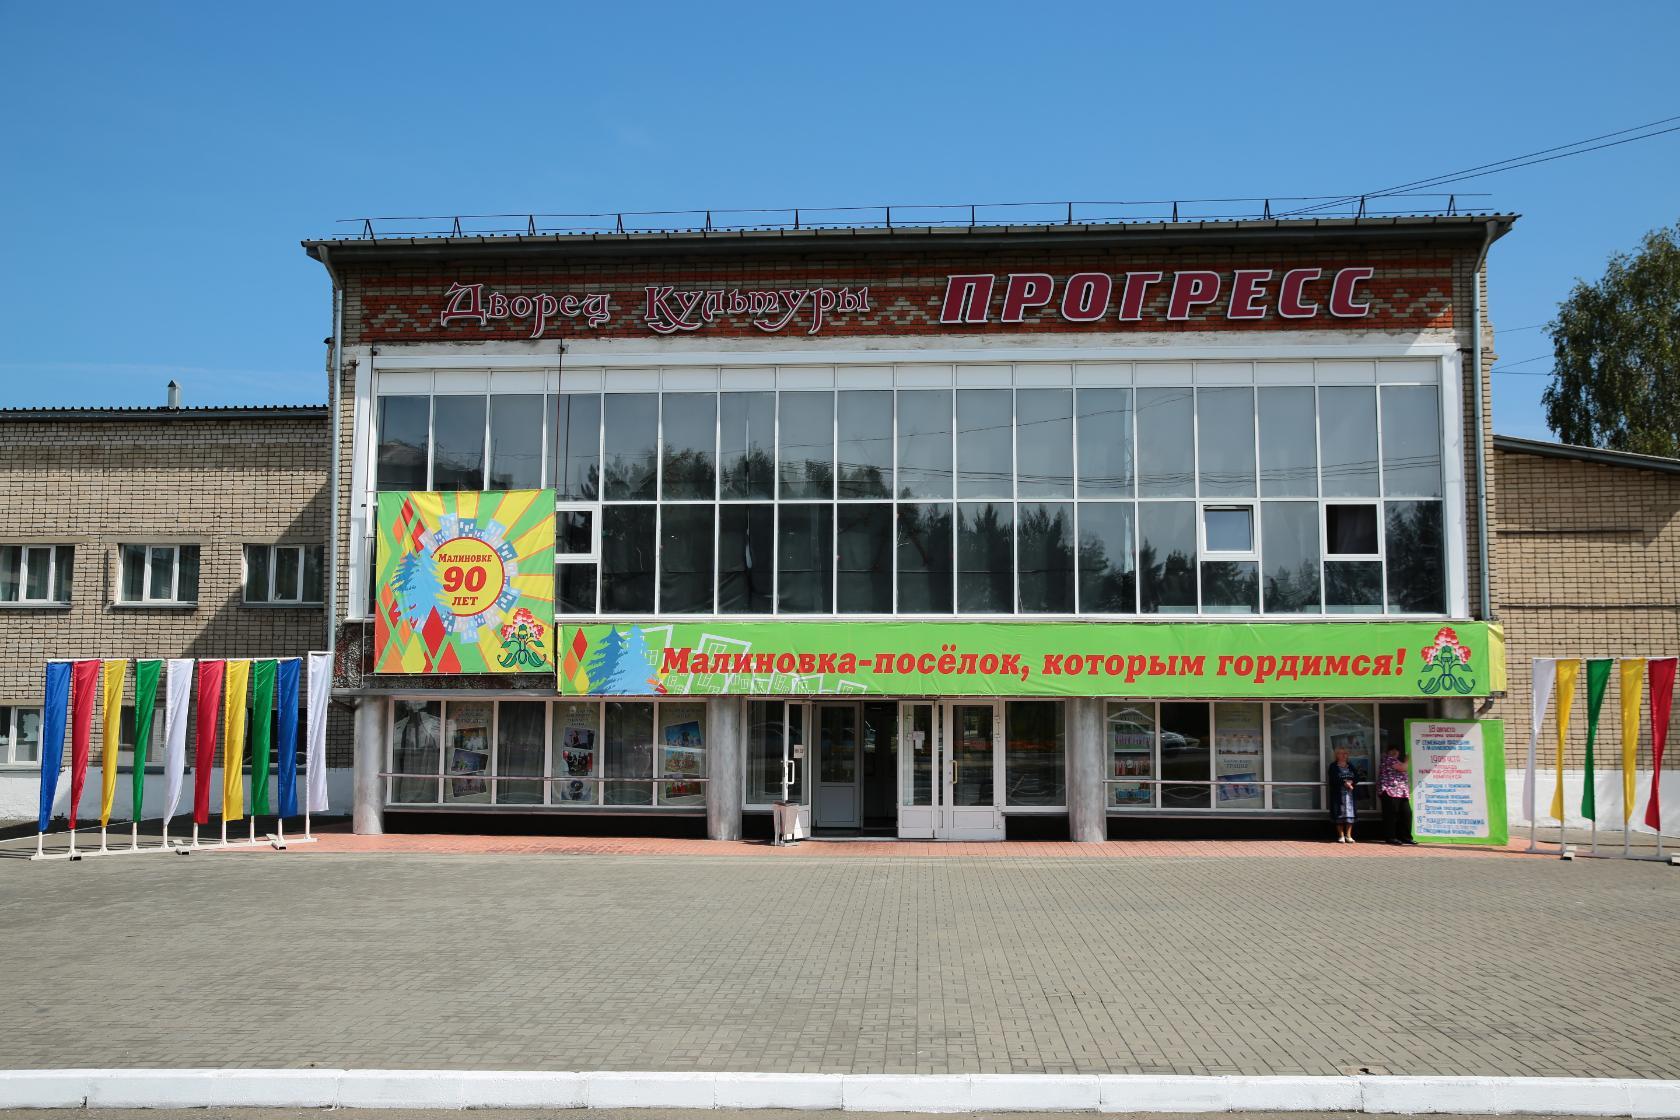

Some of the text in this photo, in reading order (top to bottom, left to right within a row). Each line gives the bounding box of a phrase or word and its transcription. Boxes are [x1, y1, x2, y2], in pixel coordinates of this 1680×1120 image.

[440, 266, 1375, 339] Дворец Культуры ПРОГРЕСС
[443, 565, 487, 593] 90
[451, 596, 479, 606] ЛЕТ
[1041, 653, 1206, 684] которым
[1216, 648, 1407, 684] гордимся!
